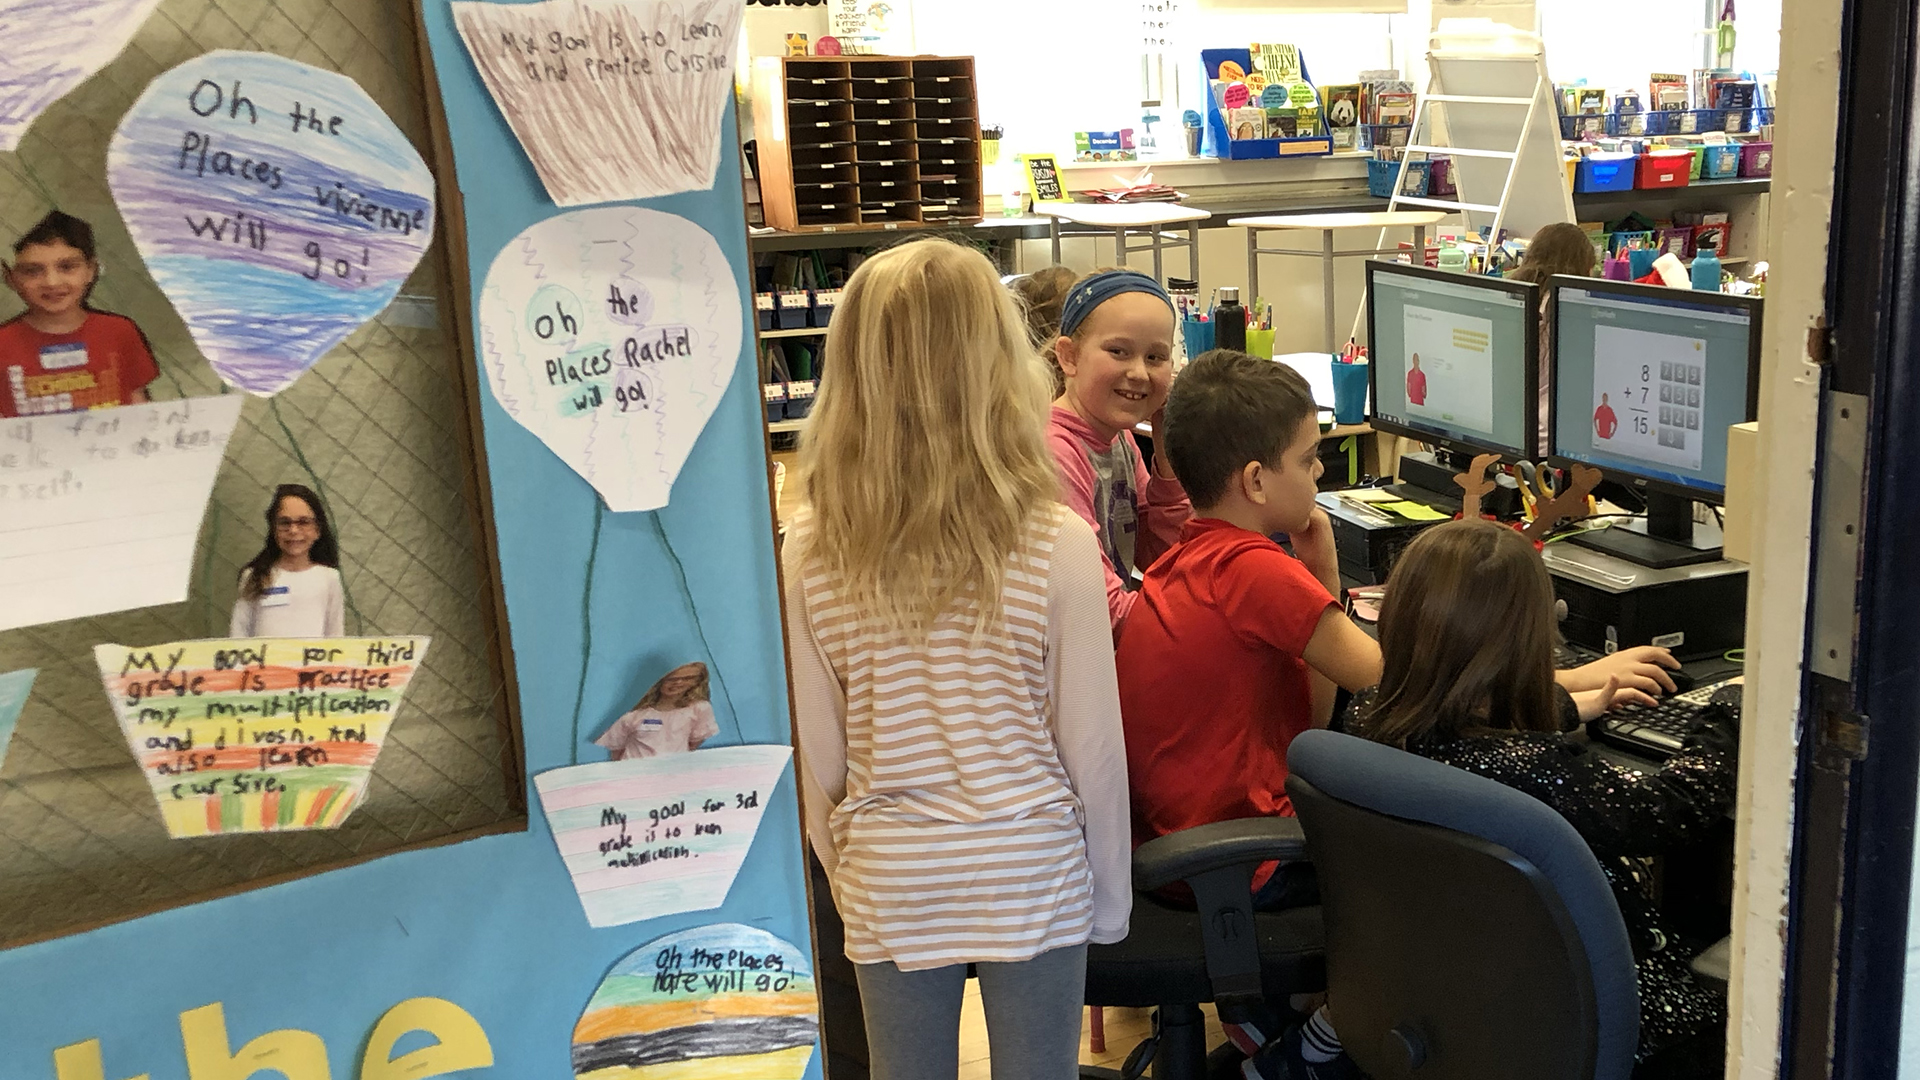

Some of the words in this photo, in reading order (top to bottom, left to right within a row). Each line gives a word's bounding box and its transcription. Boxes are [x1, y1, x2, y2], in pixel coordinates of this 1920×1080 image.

[641, 30, 666, 47] to
[526, 57, 569, 82] and
[188, 78, 257, 125] Oh
[289, 101, 344, 136] the
[177, 131, 282, 190] Places
[303, 241, 371, 282] go!
[607, 284, 639, 315] the
[545, 347, 612, 386] Places
[624, 329, 692, 368] Rachel
[1641, 365, 1650, 382] 8
[573, 386, 603, 411] will
[615, 381, 648, 413] go!
[1641, 387, 1649, 404] 7
[1633, 416, 1648, 434] 15
[121, 648, 185, 678] My
[367, 640, 414, 666] third
[127, 671, 205, 706] grade
[145, 728, 192, 751] and
[157, 754, 216, 775] also
[601, 806, 627, 833] My
[649, 801, 685, 827] goal
[702, 799, 726, 813] for
[736, 791, 758, 809] 3rd
[645, 829, 655, 843] is
[665, 826, 681, 839] to
[656, 945, 682, 970] Oh
[690, 947, 723, 970] the
[653, 970, 698, 995] Nate
[703, 971, 744, 994] will
[755, 967, 796, 993] go!
